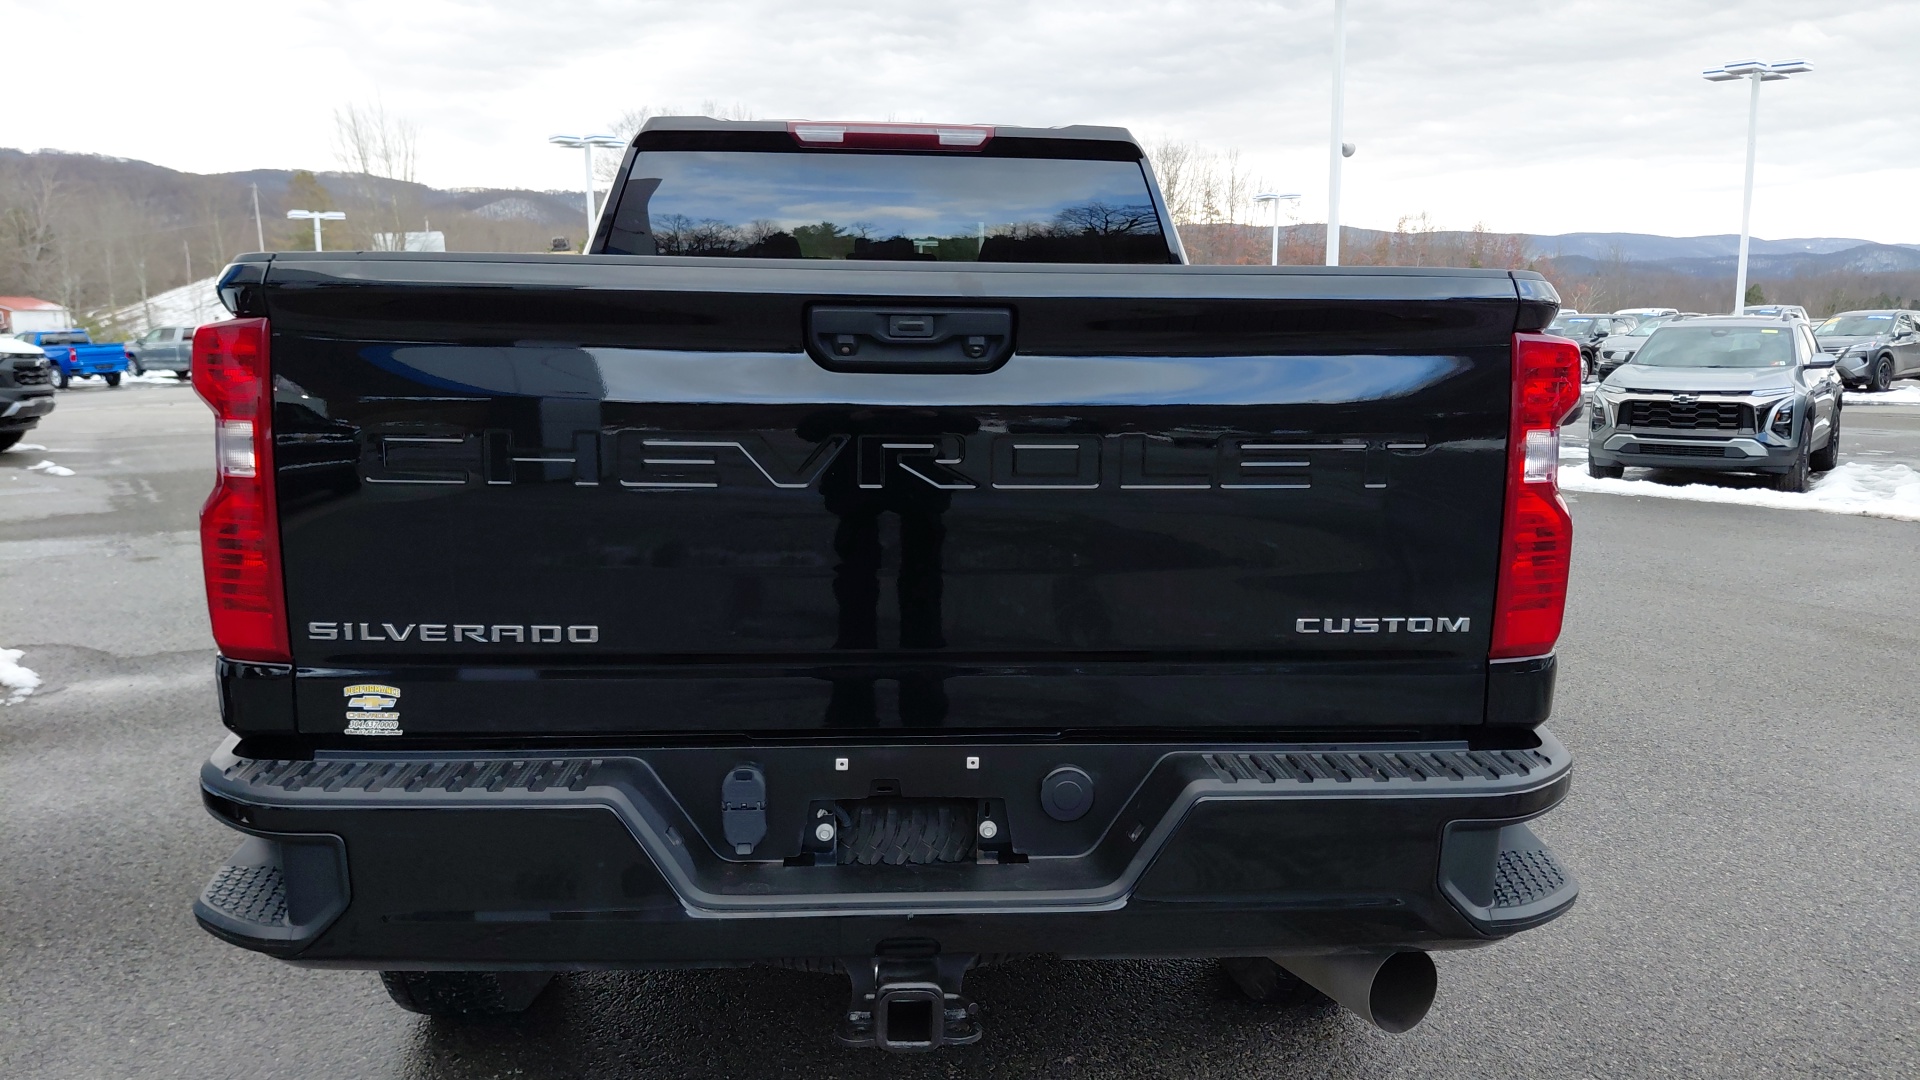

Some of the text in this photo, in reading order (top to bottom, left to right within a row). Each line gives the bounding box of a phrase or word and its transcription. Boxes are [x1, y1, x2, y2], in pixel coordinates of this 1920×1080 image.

[362, 430, 1427, 490] CHEVROLET
[308, 622, 600, 643] SILVERADO
[1295, 617, 1471, 633] CUSTOM
